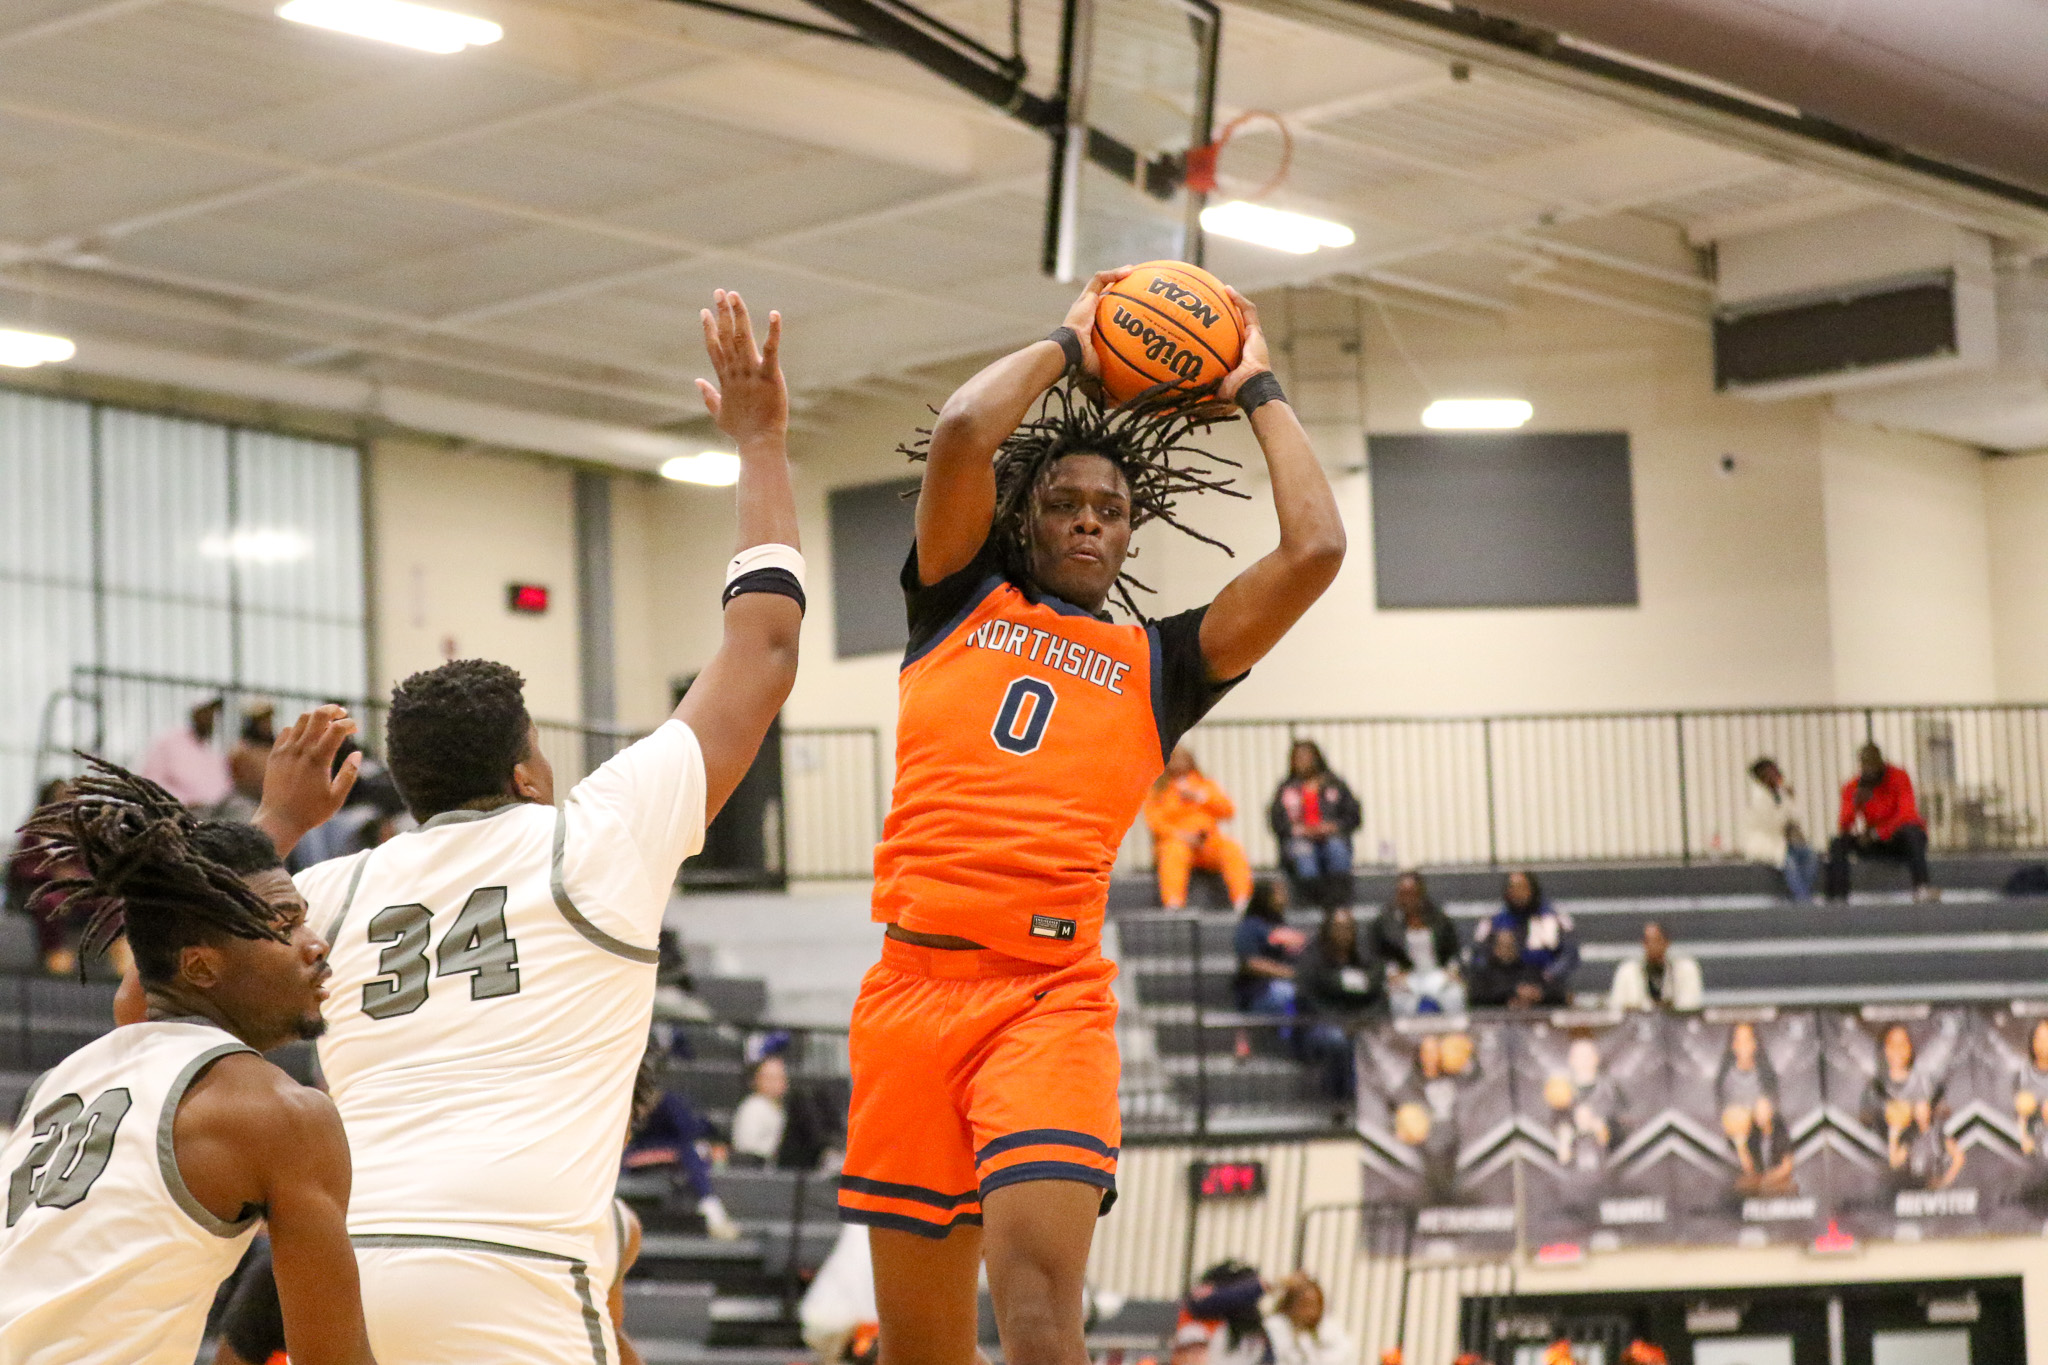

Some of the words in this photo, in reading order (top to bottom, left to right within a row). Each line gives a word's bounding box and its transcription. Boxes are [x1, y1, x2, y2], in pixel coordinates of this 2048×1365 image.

[1148, 277, 1221, 330] NCAA
[1112, 305, 1204, 383] Wilson
[966, 619, 1131, 695] NORTHSIDE
[990, 675, 1058, 756] 0
[362, 886, 520, 1020] 34
[1061, 926, 1071, 936] M
[6, 1087, 132, 1227] 20
